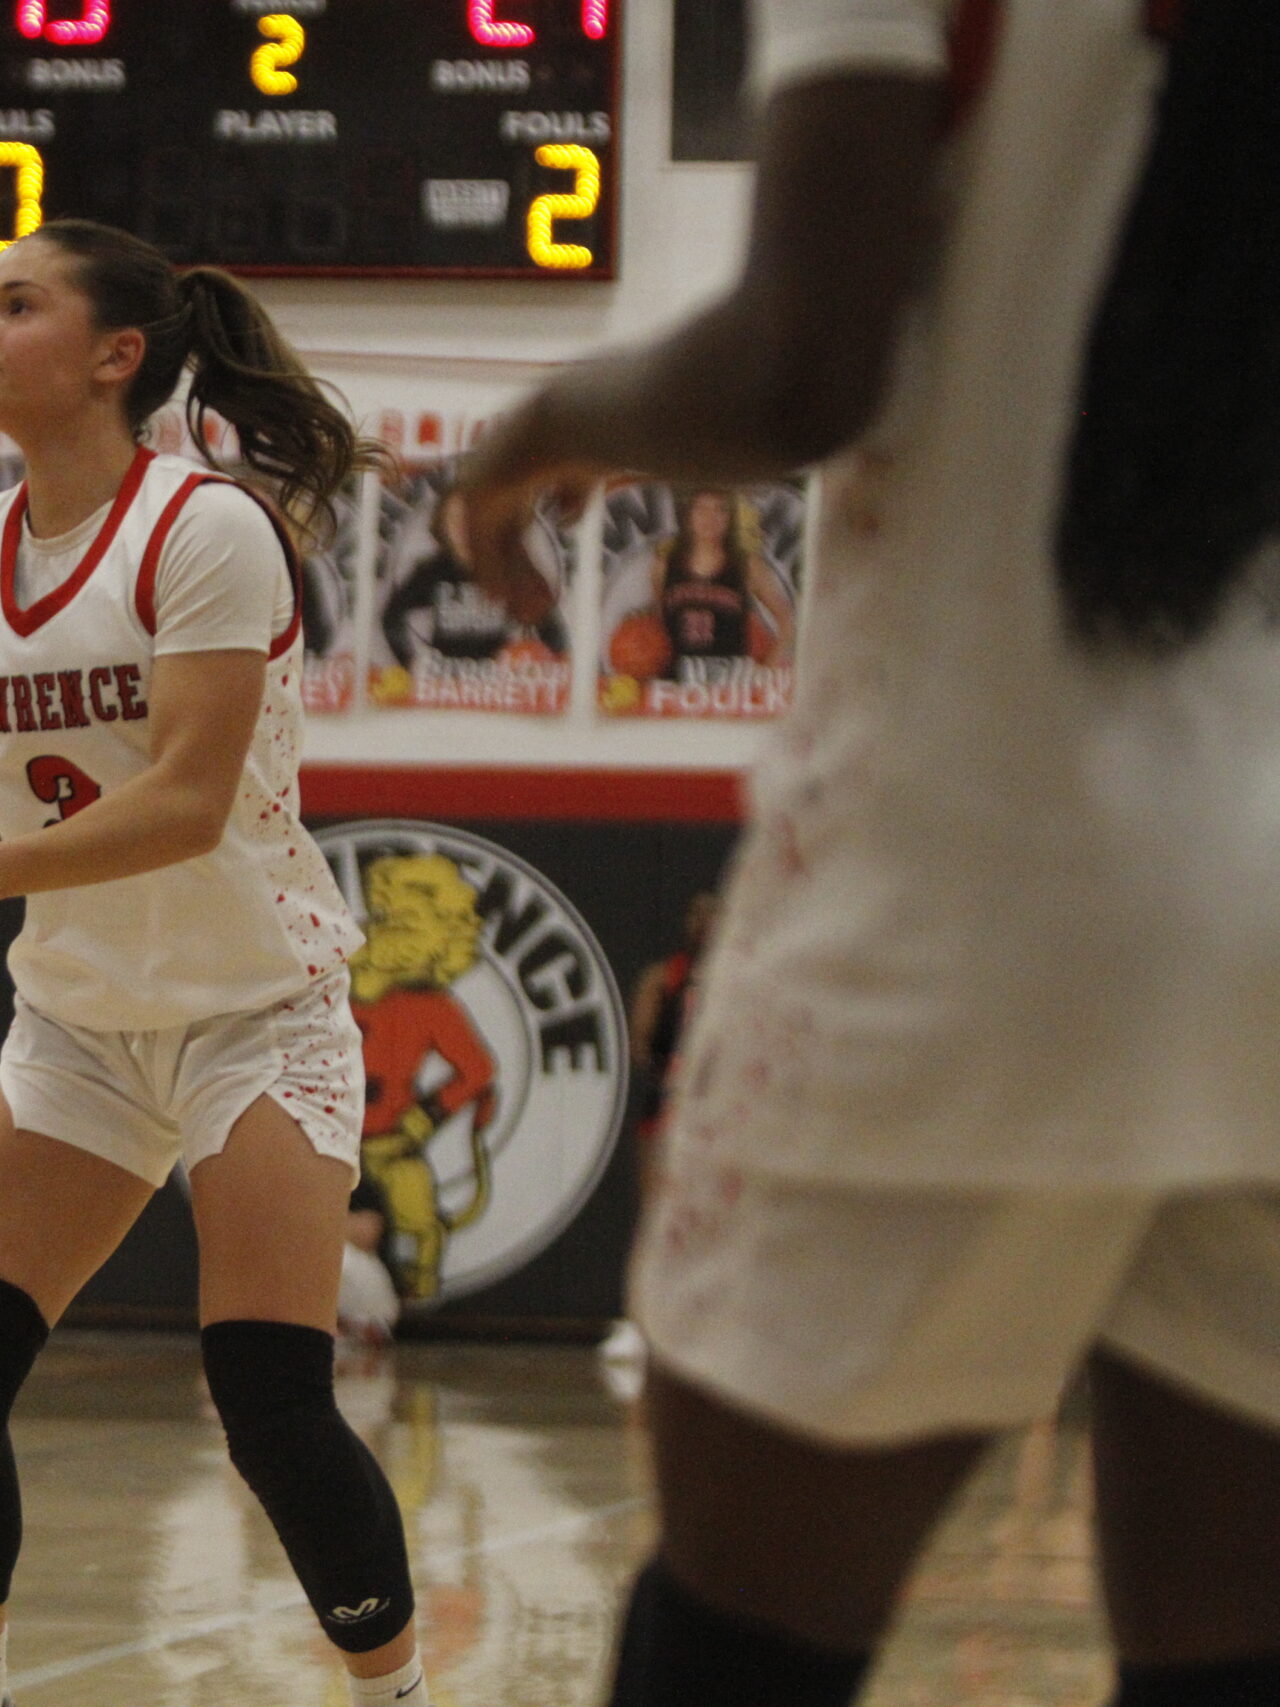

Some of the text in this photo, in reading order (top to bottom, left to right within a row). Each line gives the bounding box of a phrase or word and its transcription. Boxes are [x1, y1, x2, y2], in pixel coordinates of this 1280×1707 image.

[251, 14, 305, 95] 2
[28, 58, 125, 88] BONUS
[432, 59, 530, 91] BONUS
[217, 109, 337, 140] PLAYER
[502, 110, 610, 143] FOULS
[527, 144, 600, 269] 2
